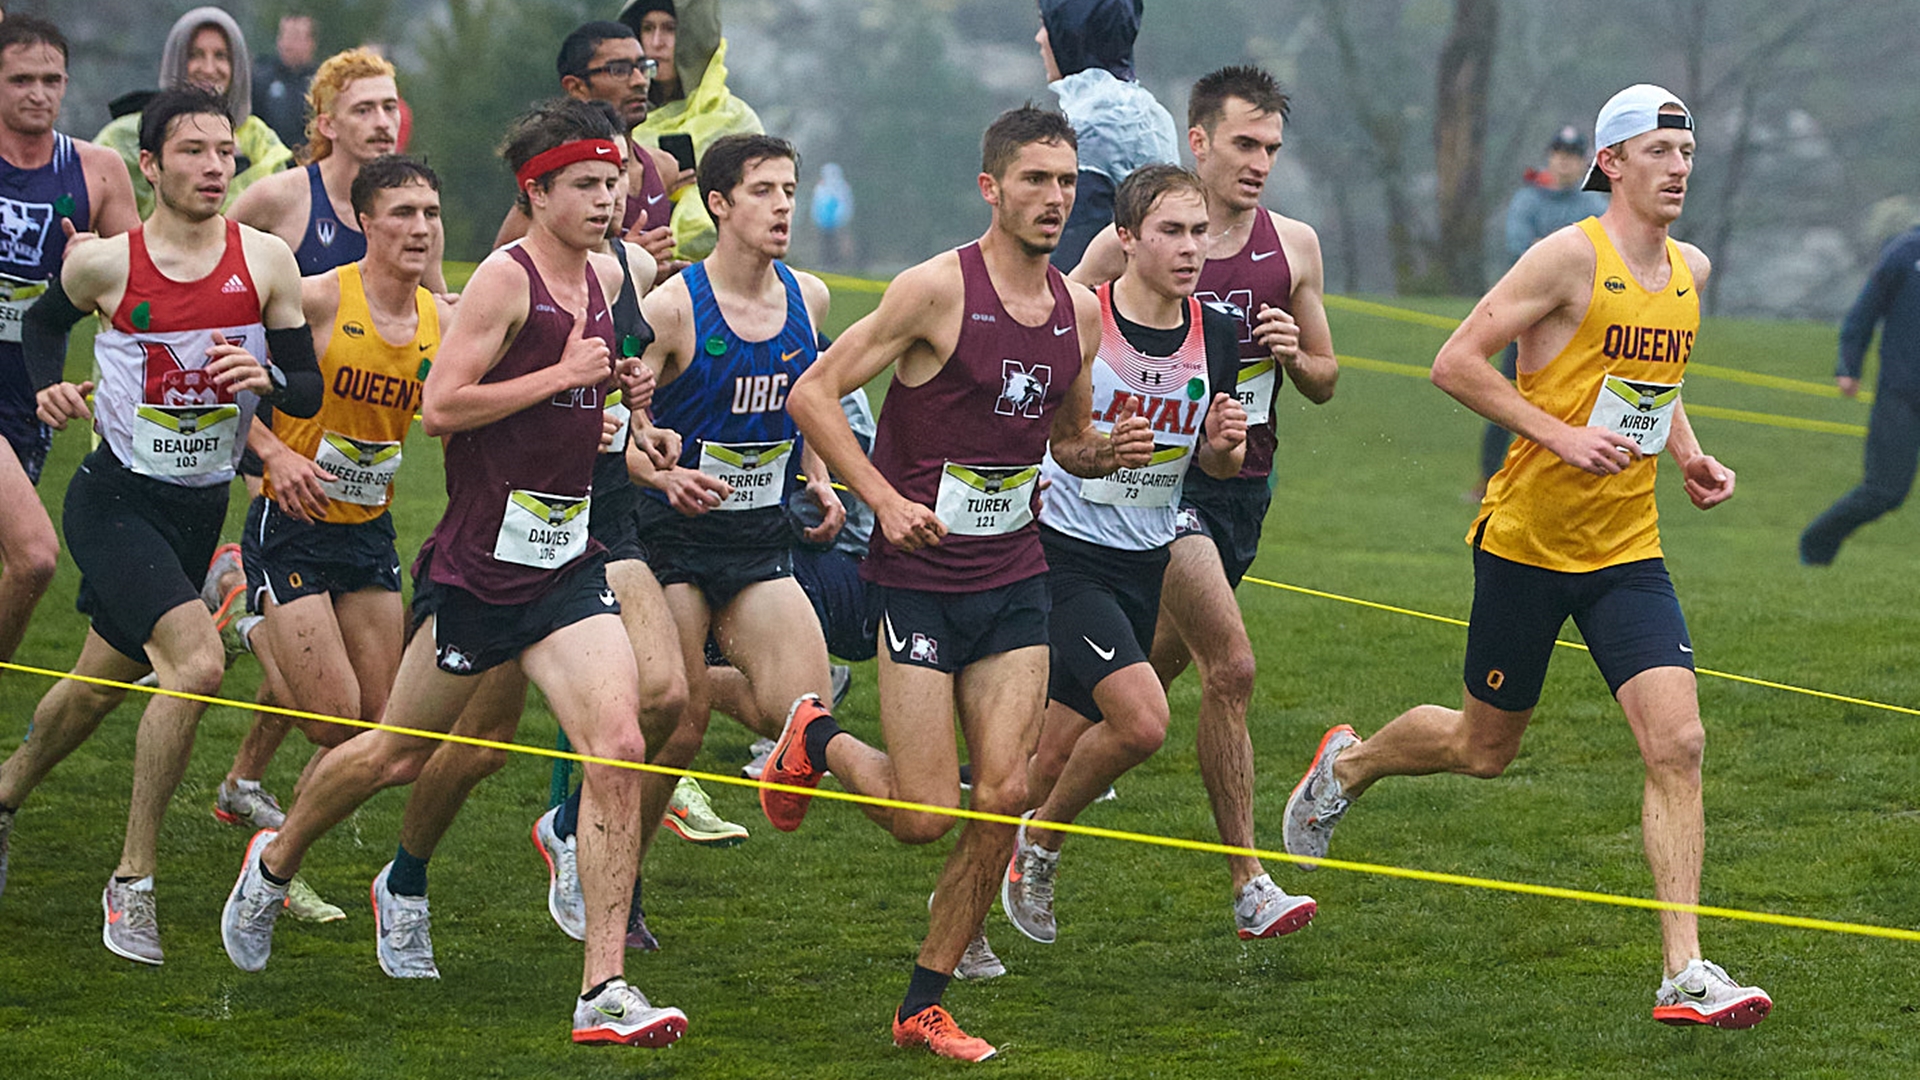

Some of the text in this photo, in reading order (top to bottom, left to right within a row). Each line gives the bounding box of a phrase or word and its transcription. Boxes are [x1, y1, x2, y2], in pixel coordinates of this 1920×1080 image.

[971, 312, 996, 322] OUA
[1602, 324, 1694, 364] QUEEN'S
[731, 373, 789, 415] UBC
[1092, 385, 1200, 436] AVAL
[1619, 414, 1660, 431] KIRBY
[152, 436, 220, 454] BEAUDET
[175, 456, 198, 468] 103
[341, 484, 363, 497] 175
[733, 490, 754, 502] 281
[1124, 487, 1140, 500] 73
[967, 498, 1013, 513] TUREK
[975, 515, 996, 528] 121
[528, 528, 571, 546] DAVIES
[539, 547, 556, 561] 176
